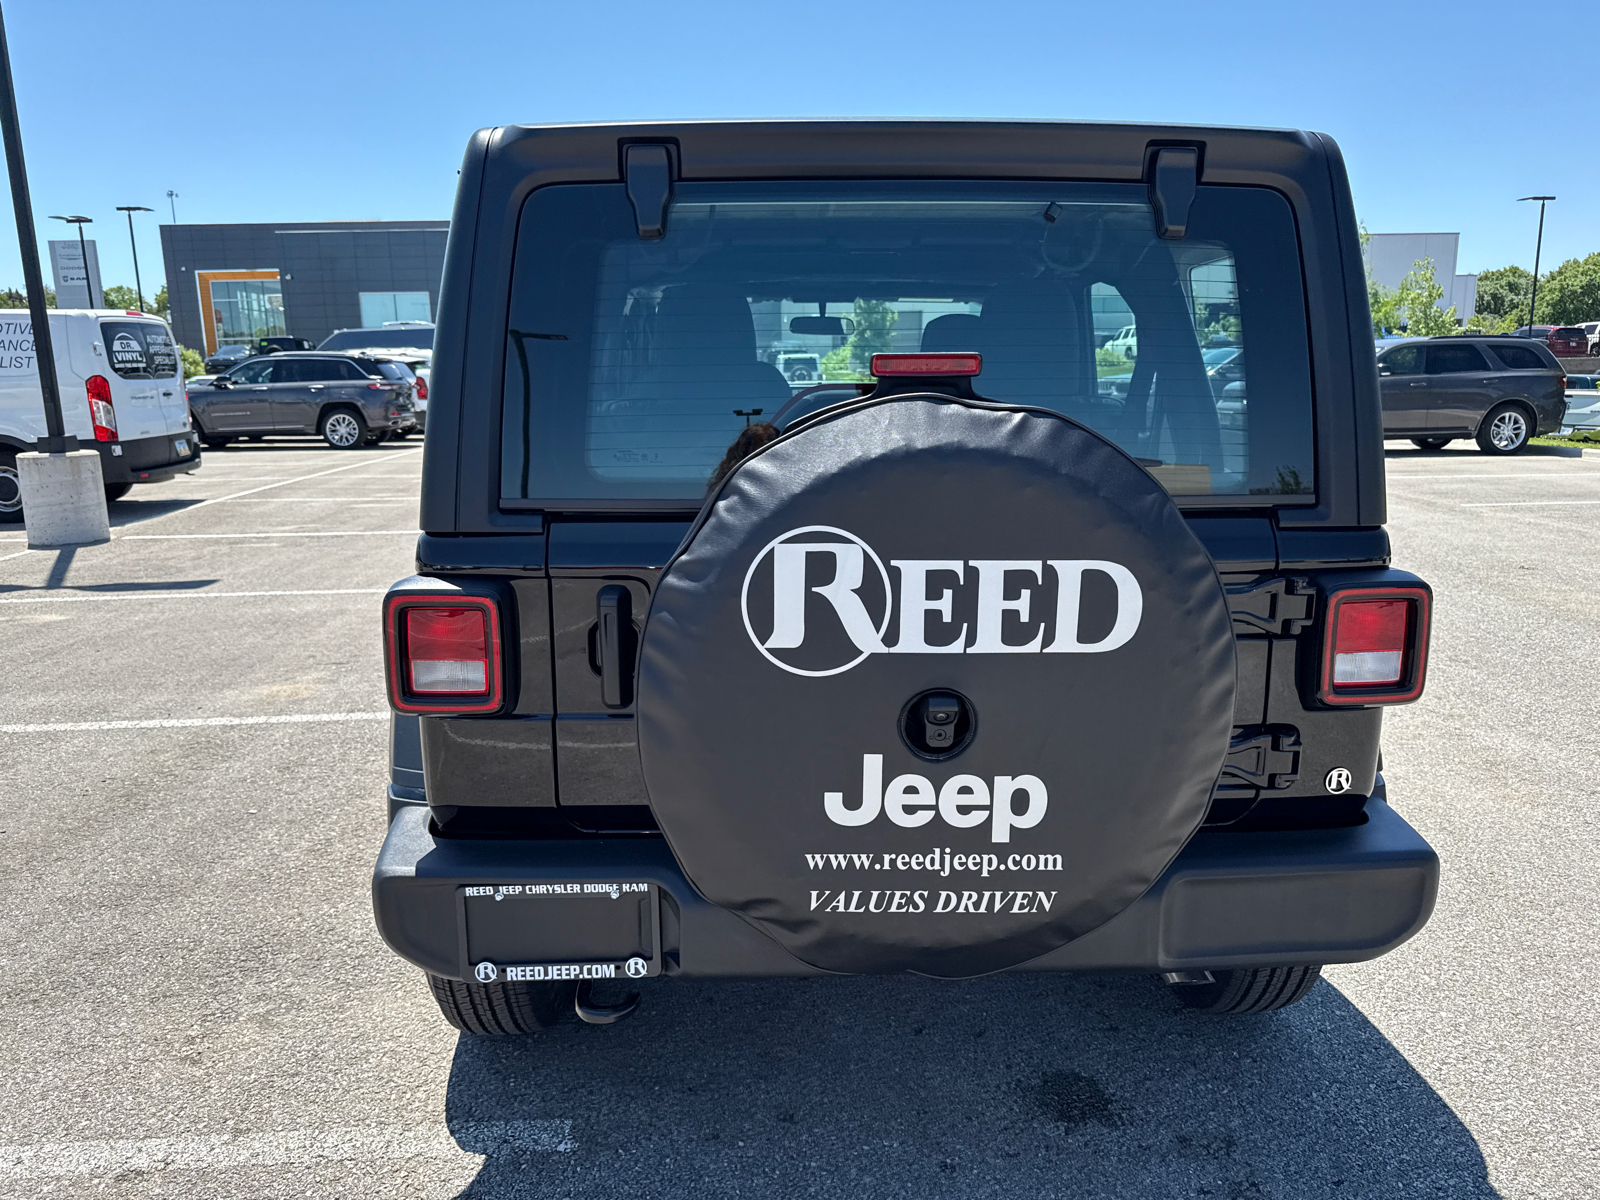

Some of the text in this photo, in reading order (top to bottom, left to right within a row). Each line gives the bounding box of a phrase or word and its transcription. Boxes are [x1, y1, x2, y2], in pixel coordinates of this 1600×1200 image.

[120, 341, 134, 349] DR.
[115, 351, 143, 362] VINYL
[761, 541, 1143, 654] REED
[824, 753, 1048, 843] Jeep
[805, 848, 1063, 877] www.reedjeep.com
[465, 882, 648, 897] REED JEEP CHRYSLER DODGE RAM
[809, 890, 1058, 913] VALUES DRIVEN
[506, 964, 615, 981] REEDJEEP.COM
